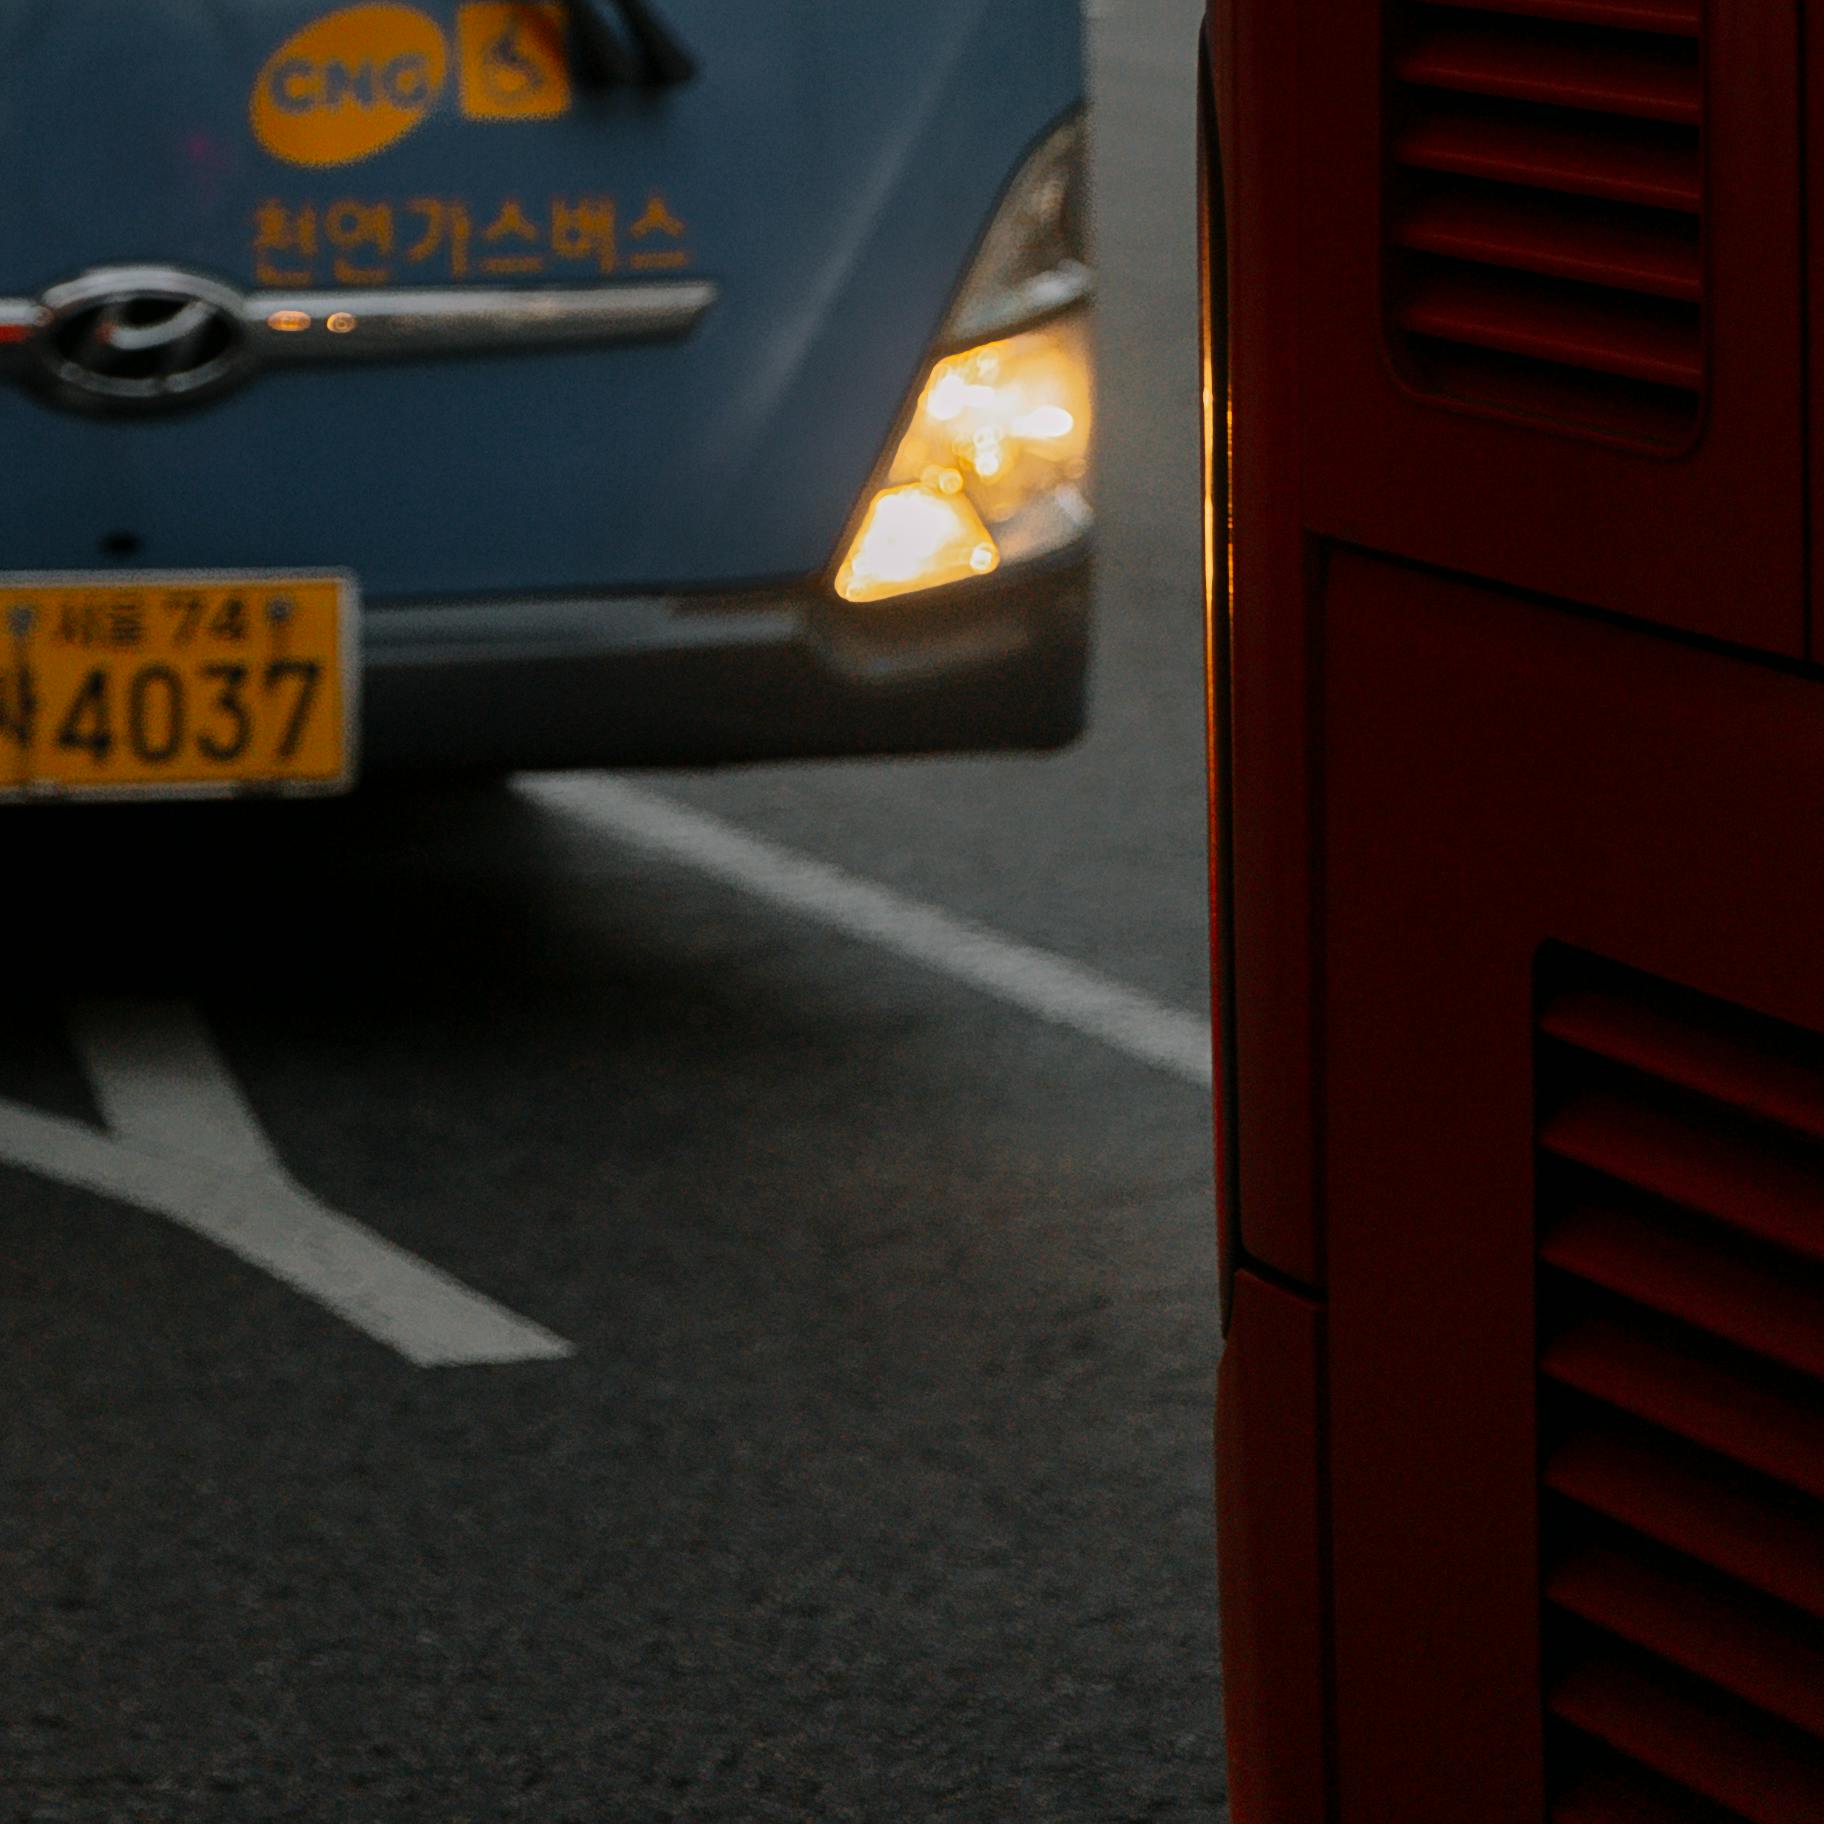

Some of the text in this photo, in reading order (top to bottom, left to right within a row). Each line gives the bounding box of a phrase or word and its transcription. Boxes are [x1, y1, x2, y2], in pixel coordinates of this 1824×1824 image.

[270, 50, 432, 117] CNG
[252, 197, 691, 287] 천연가스버스
[56, 659, 322, 764] 4037
